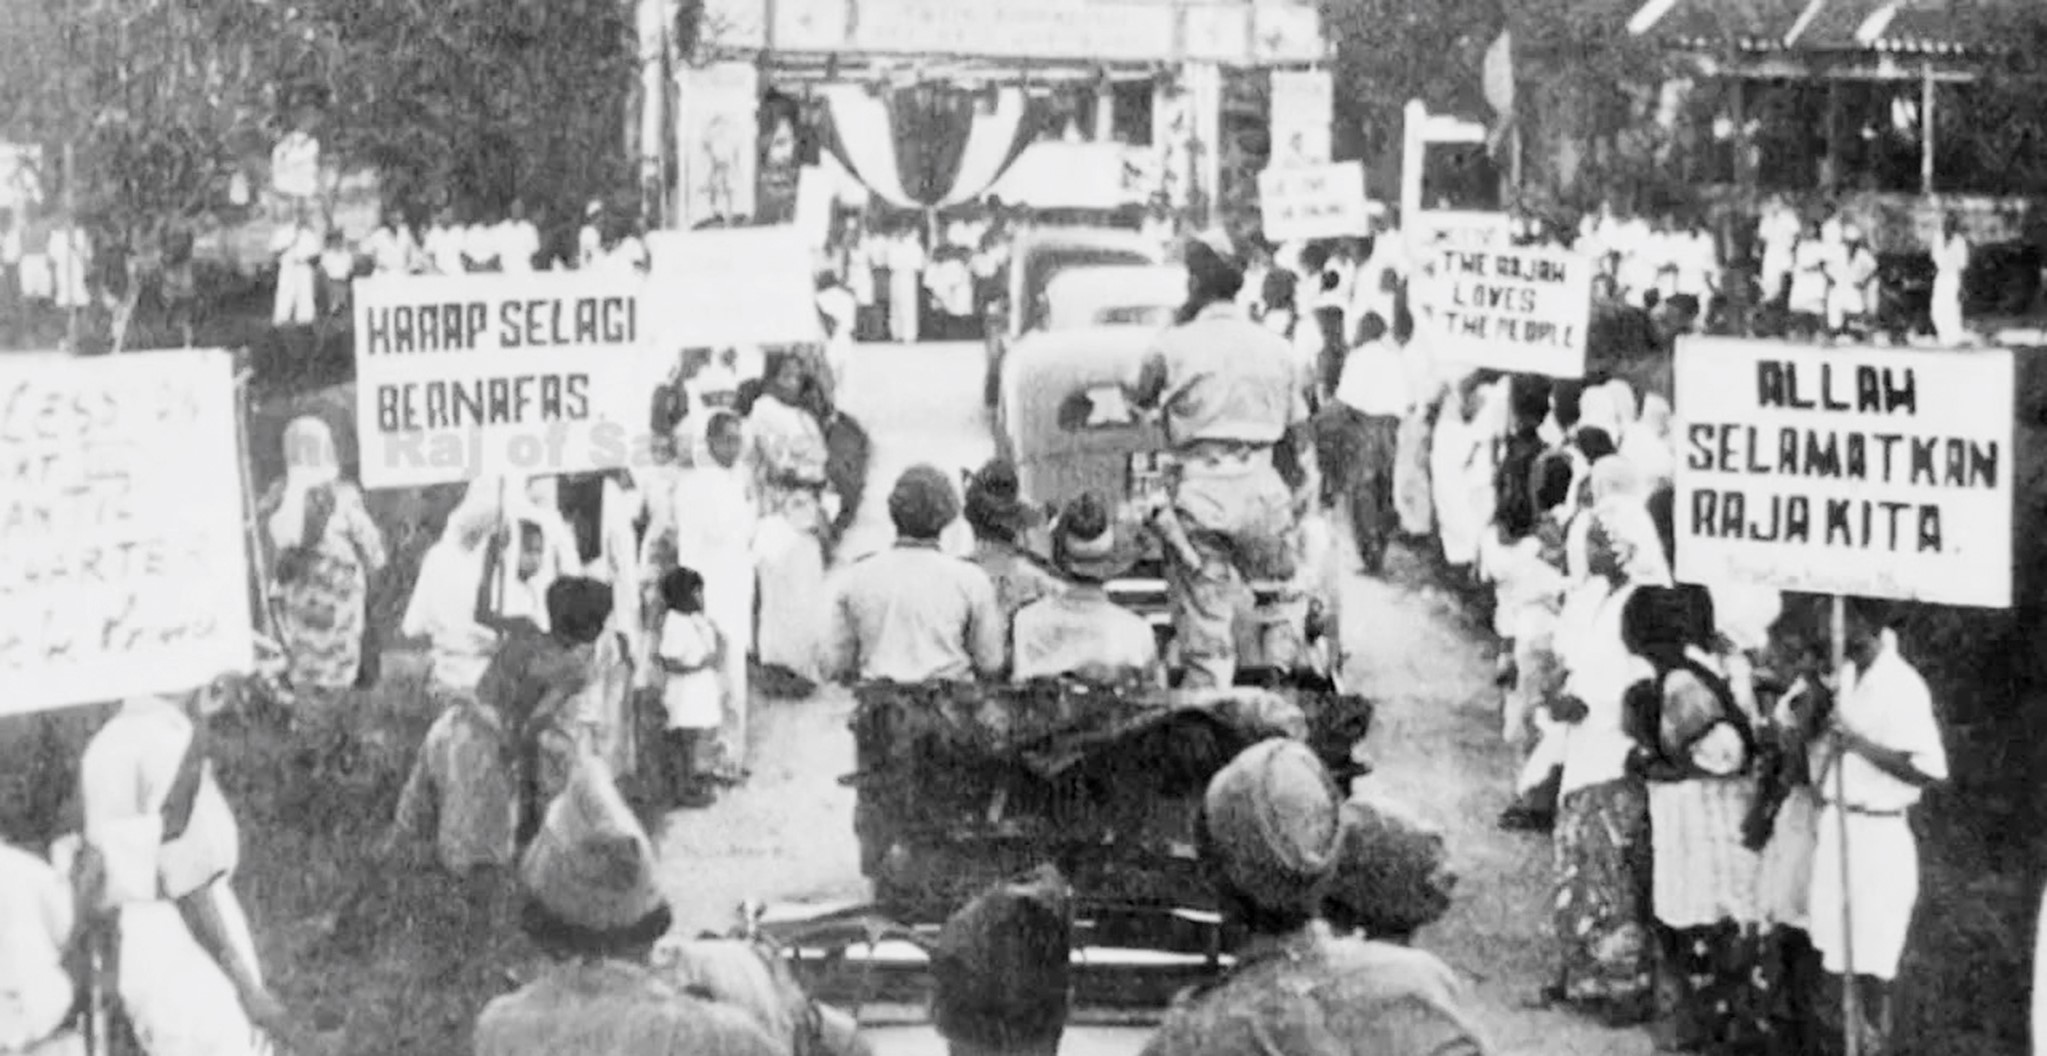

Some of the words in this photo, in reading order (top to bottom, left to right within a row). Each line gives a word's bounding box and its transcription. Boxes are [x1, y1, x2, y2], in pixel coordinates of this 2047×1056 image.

[1443, 250, 1488, 276] THE
[499, 296, 636, 349] SELAGI
[1453, 282, 1536, 313] LOVES
[1445, 312, 1487, 340] THE
[1756, 359, 1917, 416] ALLAH
[1687, 423, 1999, 489] SELAMATKAN
[1691, 488, 1811, 544] RAJA
